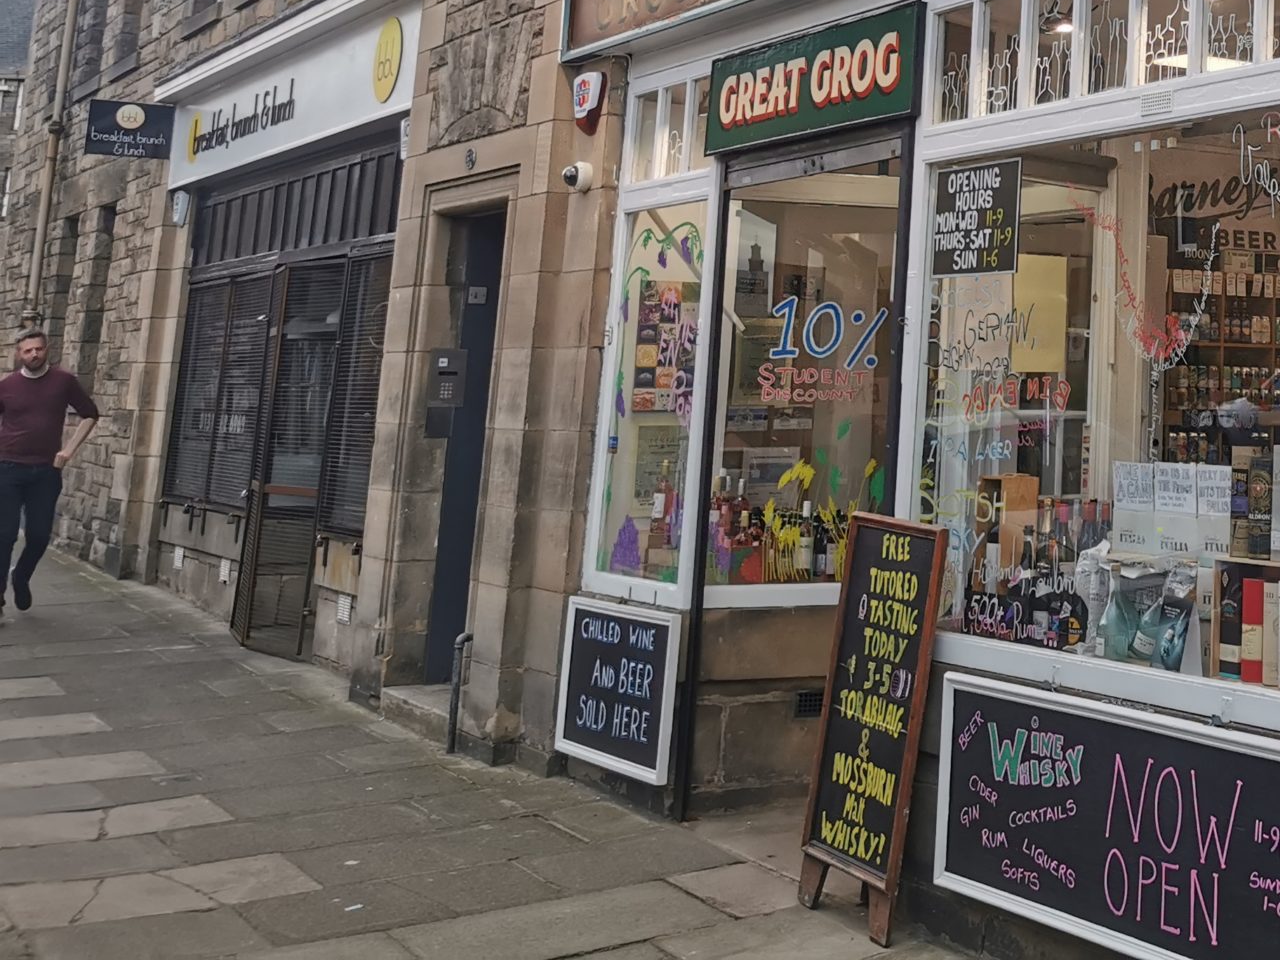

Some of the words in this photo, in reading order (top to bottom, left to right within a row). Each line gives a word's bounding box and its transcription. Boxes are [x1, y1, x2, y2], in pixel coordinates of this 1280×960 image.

[719, 55, 807, 129] GREAT
[810, 31, 901, 110] GROG
[947, 166, 1002, 194] OPENING
[955, 189, 993, 212] HOURS
[986, 208, 1004, 227] 11-9
[993, 226, 1012, 247] 11-9
[1218, 228, 1278, 251] BEER
[952, 249, 978, 270] SUN
[983, 248, 999, 268] 1-6
[769, 295, 889, 369] 10%
[757, 362, 869, 386] STUDENT
[761, 385, 857, 403] DISCOUNT
[882, 533, 912, 562] FREE
[869, 567, 919, 602] TUTORED
[581, 617, 621, 643] CHILLED
[629, 625, 656, 652] WINE
[869, 598, 919, 636] TASTING
[863, 627, 909, 665] TODAY
[590, 655, 615, 690] AND
[618, 657, 654, 700] BEER
[863, 660, 892, 695] 3-5
[576, 694, 607, 731] SOLD
[611, 703, 650, 742] HERE
[958, 710, 984, 751] BEER
[832, 751, 896, 807] MOSSBURN
[968, 775, 998, 807] CIDER
[960, 804, 980, 827] GIN
[1008, 800, 1077, 828] COCKTAILS
[1104, 753, 1244, 869] NOW
[821, 810, 886, 866] WHISKY!
[982, 828, 1008, 849] RUM
[1001, 858, 1040, 892] SOFTS
[1022, 837, 1076, 890] LIQUERS
[1103, 847, 1220, 946] OPEN
